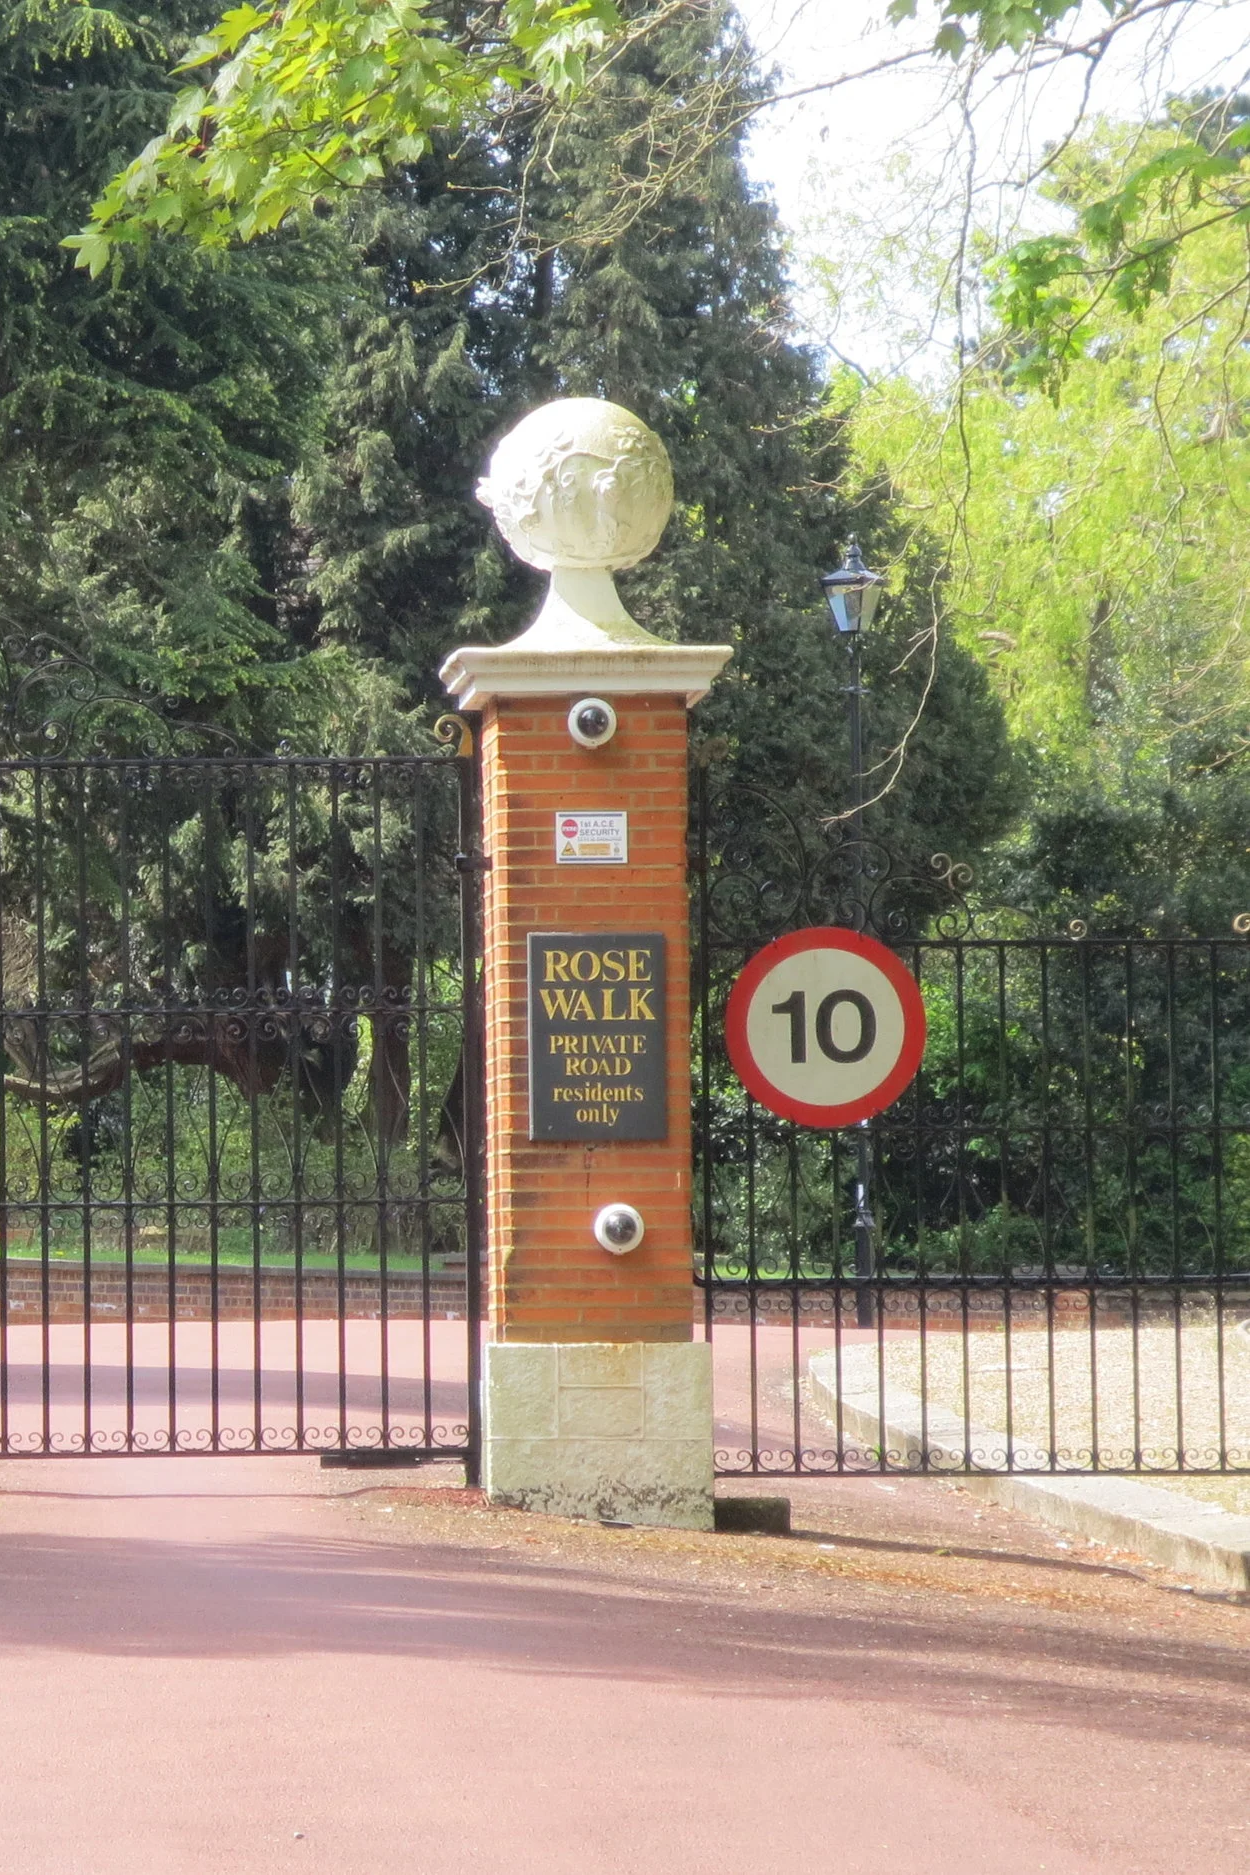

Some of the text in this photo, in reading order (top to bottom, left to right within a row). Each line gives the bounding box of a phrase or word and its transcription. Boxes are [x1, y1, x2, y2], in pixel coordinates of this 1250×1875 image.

[579, 828, 620, 836] SECURITY
[543, 949, 651, 982] ROSE
[539, 988, 656, 1021] WALK
[771, 989, 877, 1064] 10
[549, 1035, 647, 1055] PRIVATE
[565, 1057, 632, 1077] ROAD
[552, 1081, 644, 1102] residents
[576, 1103, 620, 1127] only
